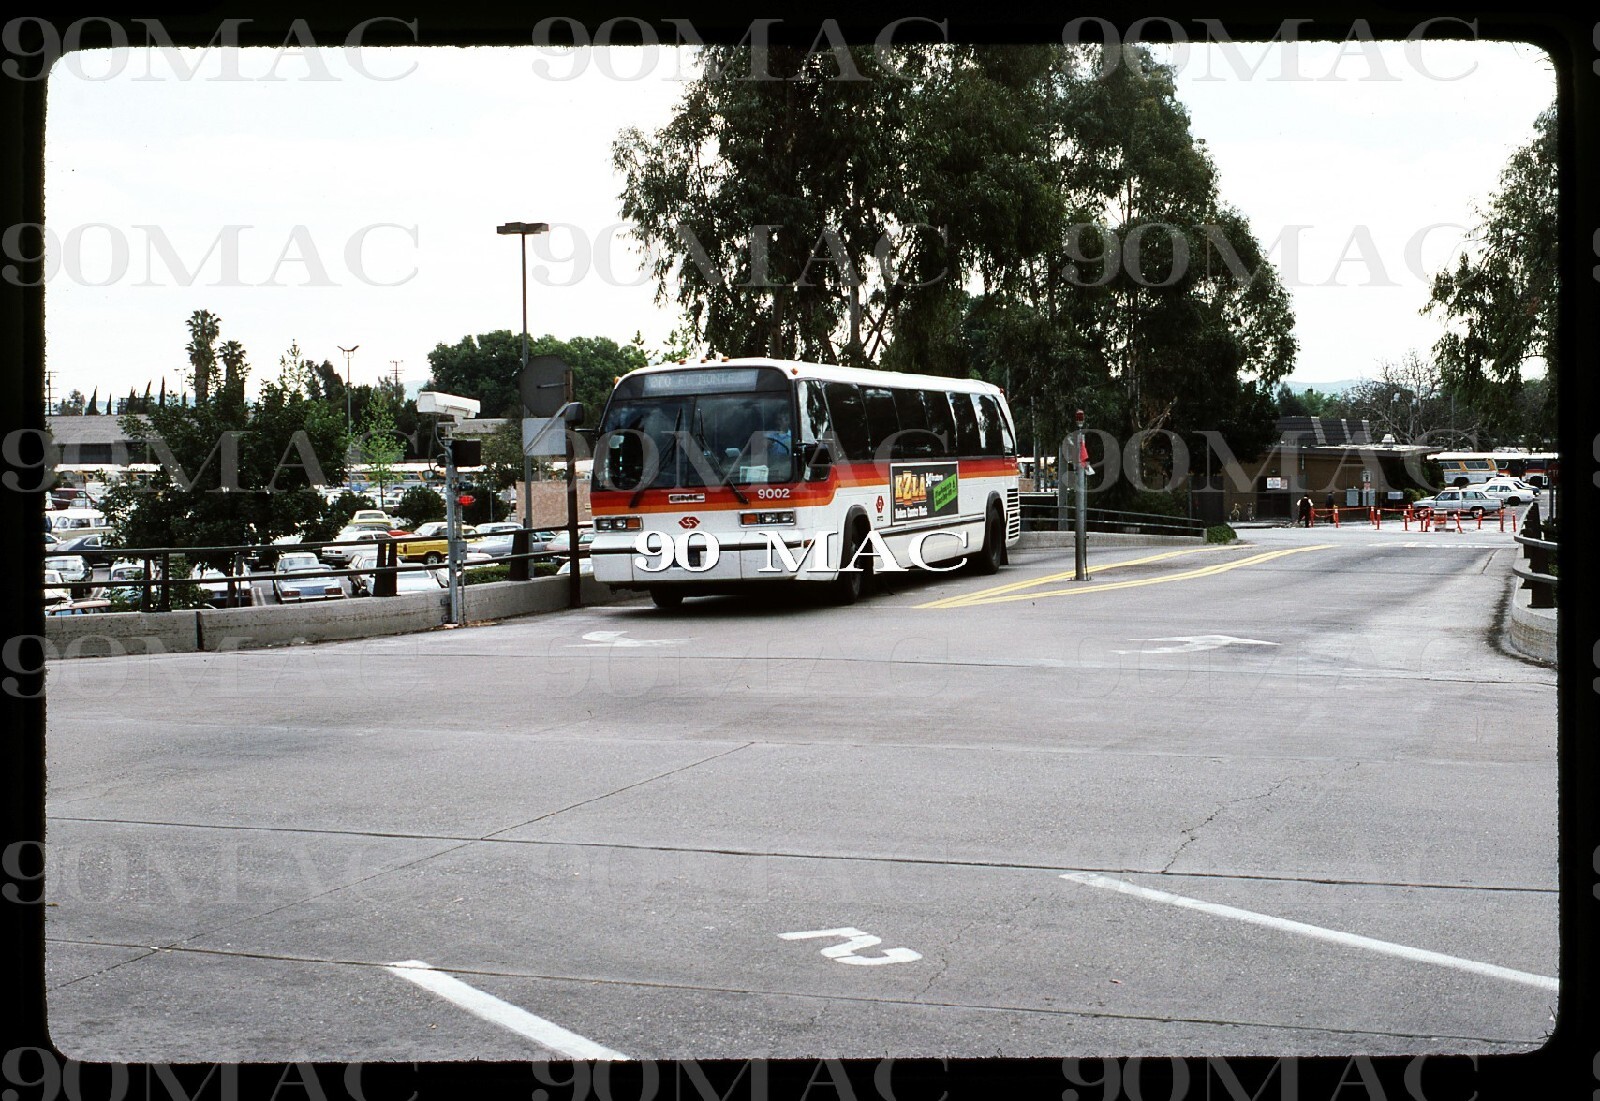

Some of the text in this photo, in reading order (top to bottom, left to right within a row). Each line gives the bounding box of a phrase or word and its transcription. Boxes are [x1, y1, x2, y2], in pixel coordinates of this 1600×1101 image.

[895, 470, 927, 504] KZLA
[669, 493, 705, 502] GMC
[757, 488, 790, 499] 9002
